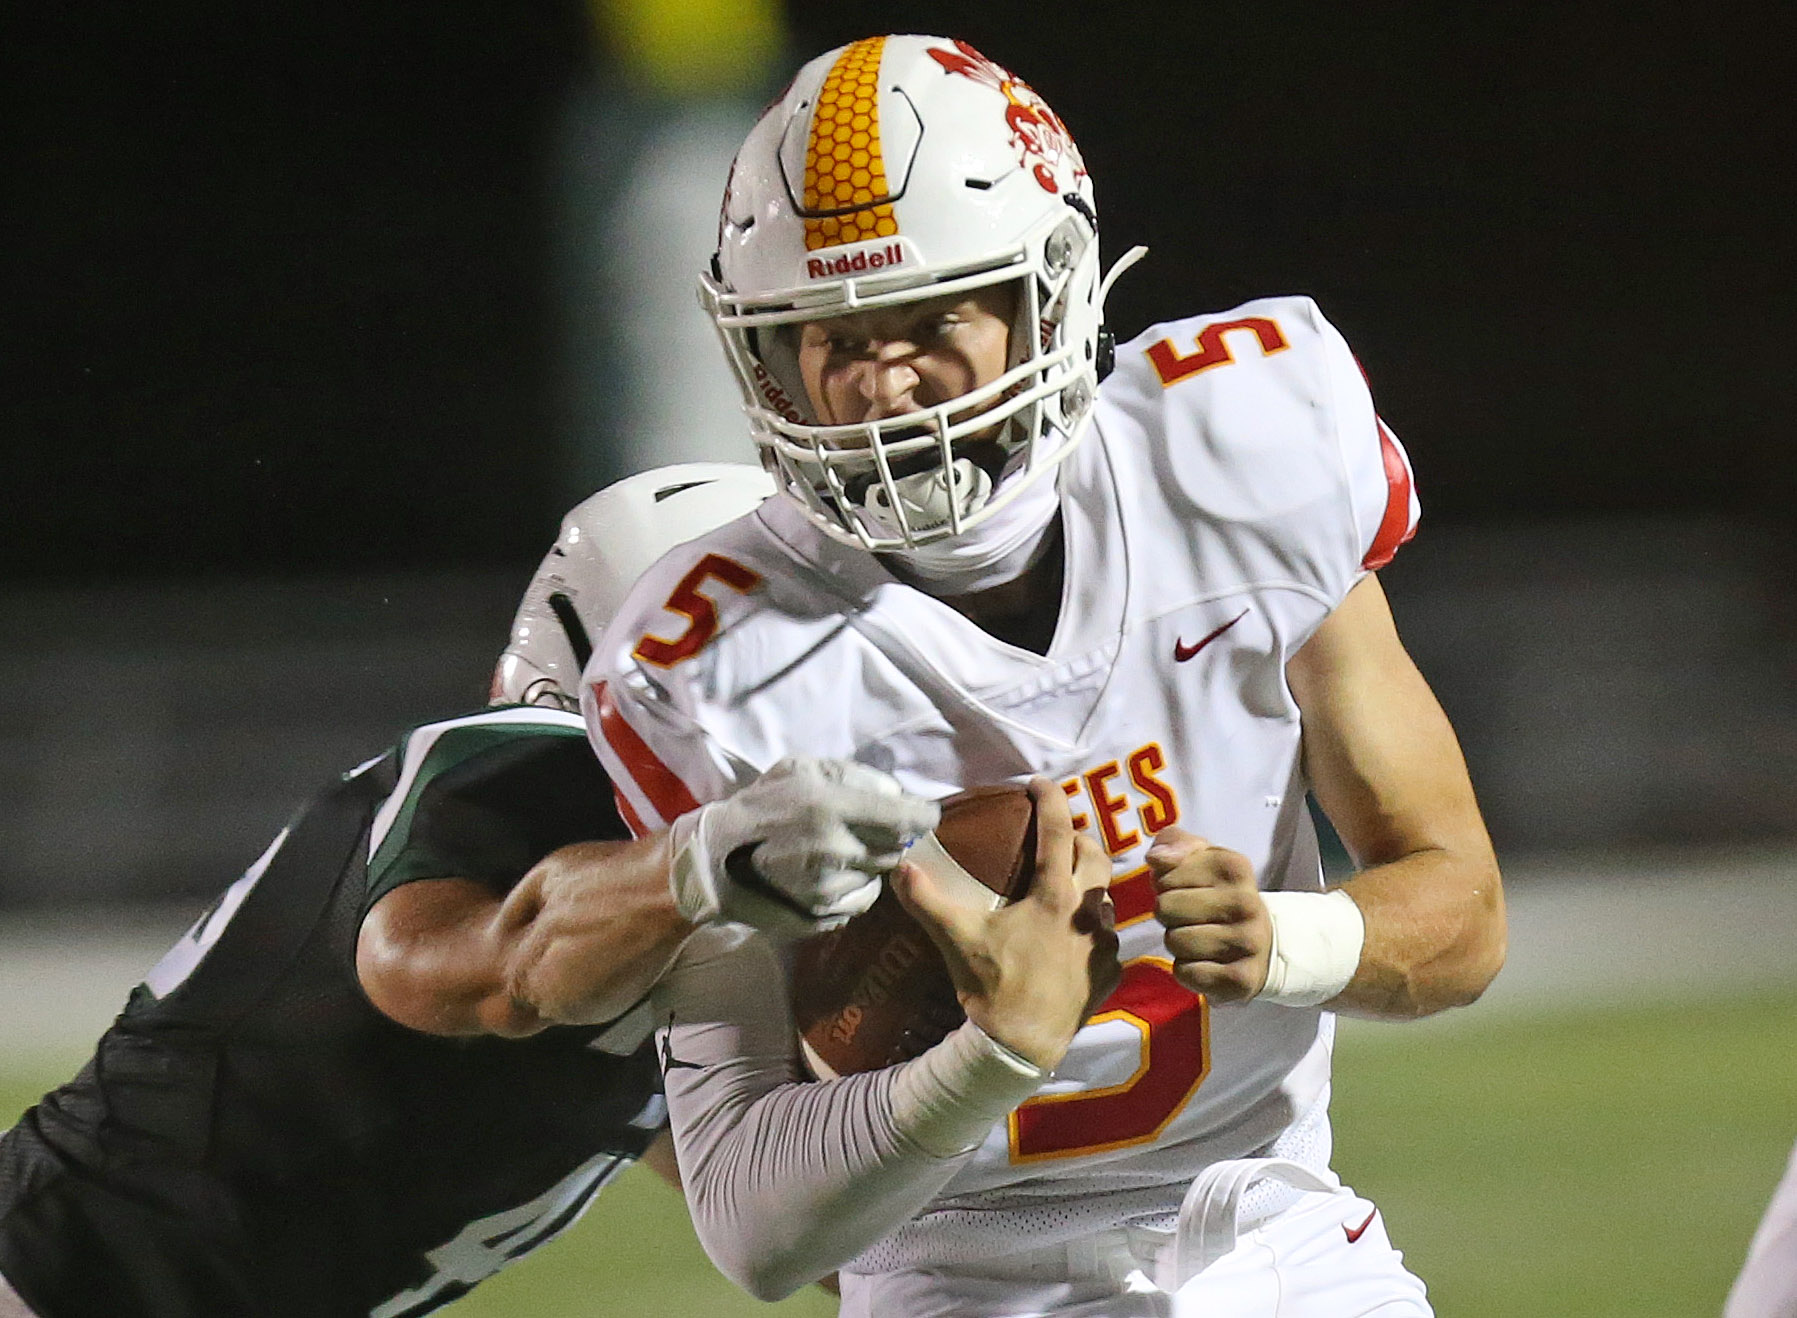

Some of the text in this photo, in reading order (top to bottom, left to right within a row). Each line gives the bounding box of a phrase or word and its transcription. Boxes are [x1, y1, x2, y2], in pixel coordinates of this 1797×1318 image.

[807, 244, 904, 279] Riddell
[1144, 316, 1291, 389] 5
[753, 363, 807, 426] Ridde
[632, 553, 765, 670] 5
[1008, 864, 1211, 1166] 5
